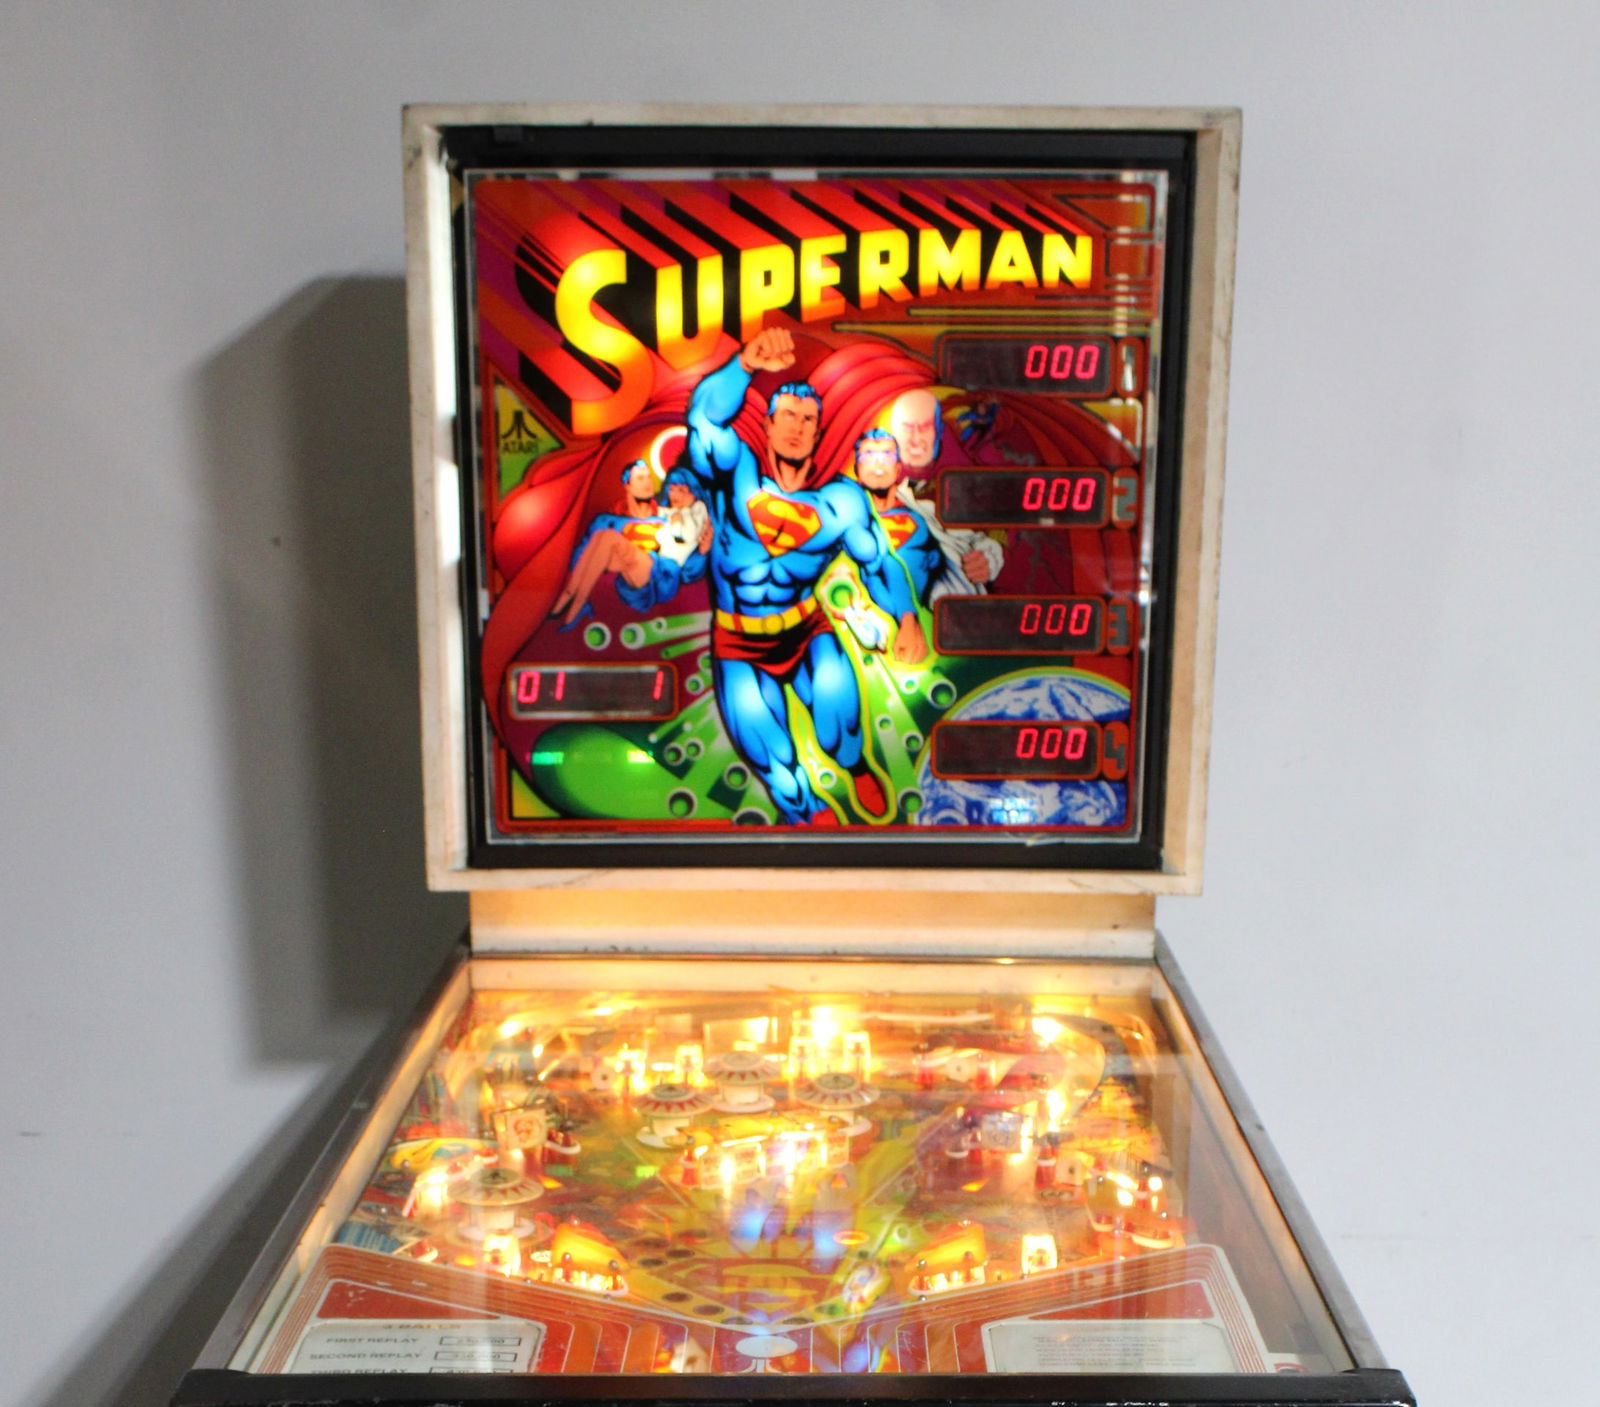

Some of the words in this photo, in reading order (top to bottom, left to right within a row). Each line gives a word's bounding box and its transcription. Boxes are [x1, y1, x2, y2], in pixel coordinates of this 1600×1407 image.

[555, 229, 1093, 435] SUPERMAN
[1024, 344, 1100, 380] 000
[501, 441, 539, 455] ATARI
[1021, 477, 1096, 512] 000
[1112, 476, 1137, 522] 2
[1019, 603, 1093, 636] 000
[1108, 604, 1129, 647] 3
[653, 670, 665, 700] 1
[1015, 727, 1088, 761] 000
[1105, 729, 1126, 771] 4
[309, 1352, 367, 1361] SECOND
[369, 1352, 422, 1360] REPLAY
[325, 1337, 364, 1345] FIRST
